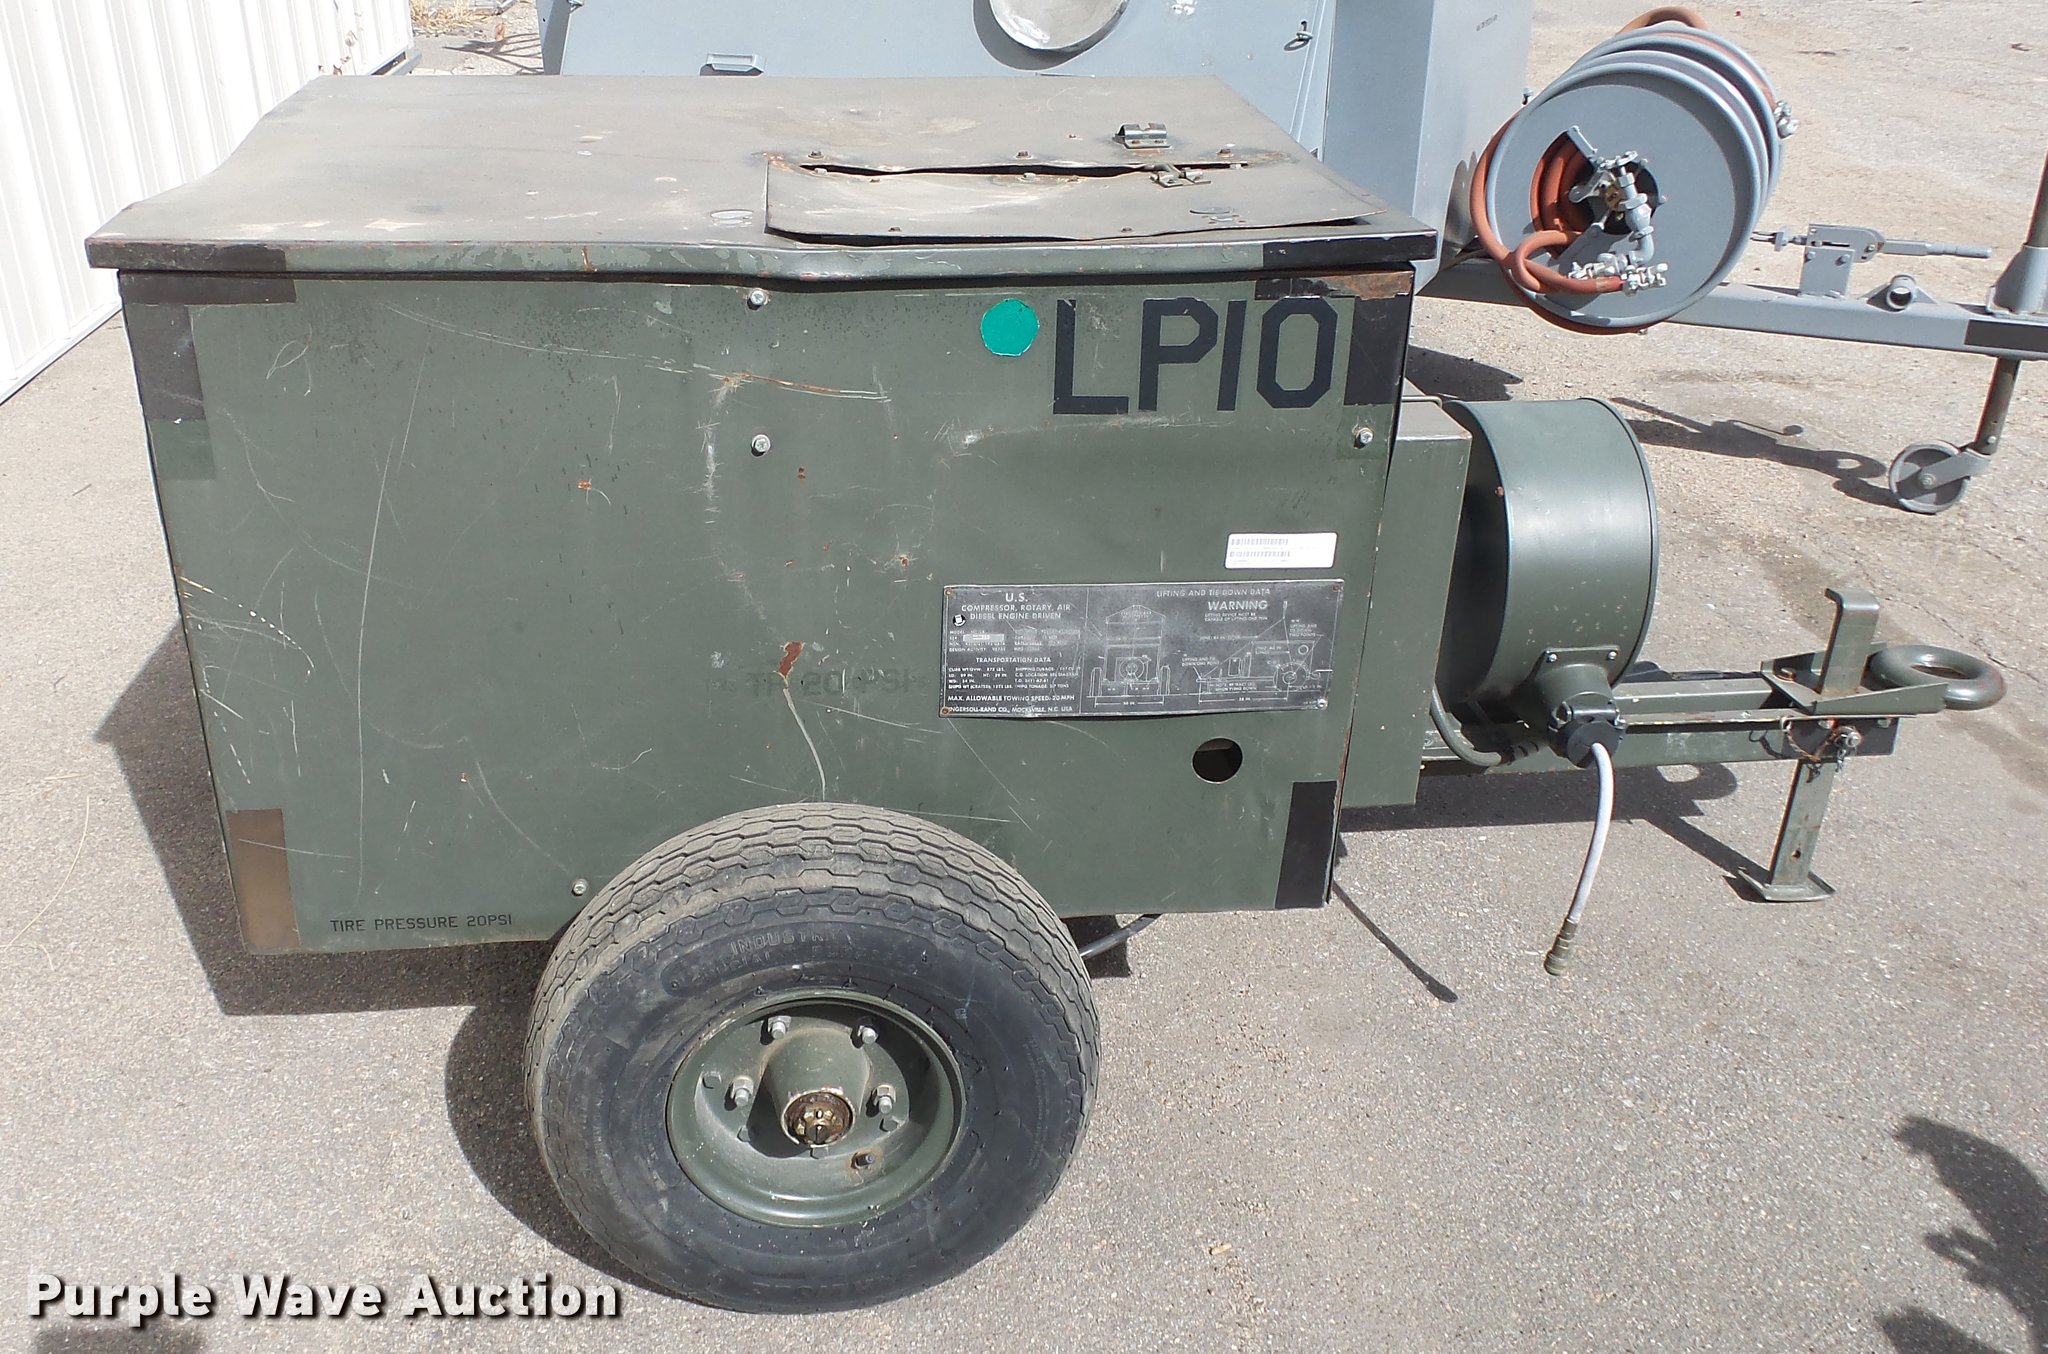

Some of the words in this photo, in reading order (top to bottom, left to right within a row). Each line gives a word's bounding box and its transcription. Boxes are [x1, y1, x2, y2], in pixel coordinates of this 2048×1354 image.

[1250, 588, 1271, 596] DATA
[1005, 592, 1029, 603] U.S.
[961, 604, 1018, 613] COMPRESSOR,
[1056, 603, 1072, 611] AIR
[1207, 600, 1268, 611] WARNING
[970, 612, 996, 620] DIESEL
[998, 612, 1030, 620] ENGINE
[1031, 612, 1062, 620] DRIVEN
[330, 919, 366, 932] TIRE
[374, 916, 459, 931] PRESSURE
[466, 914, 513, 928] 20PSI
